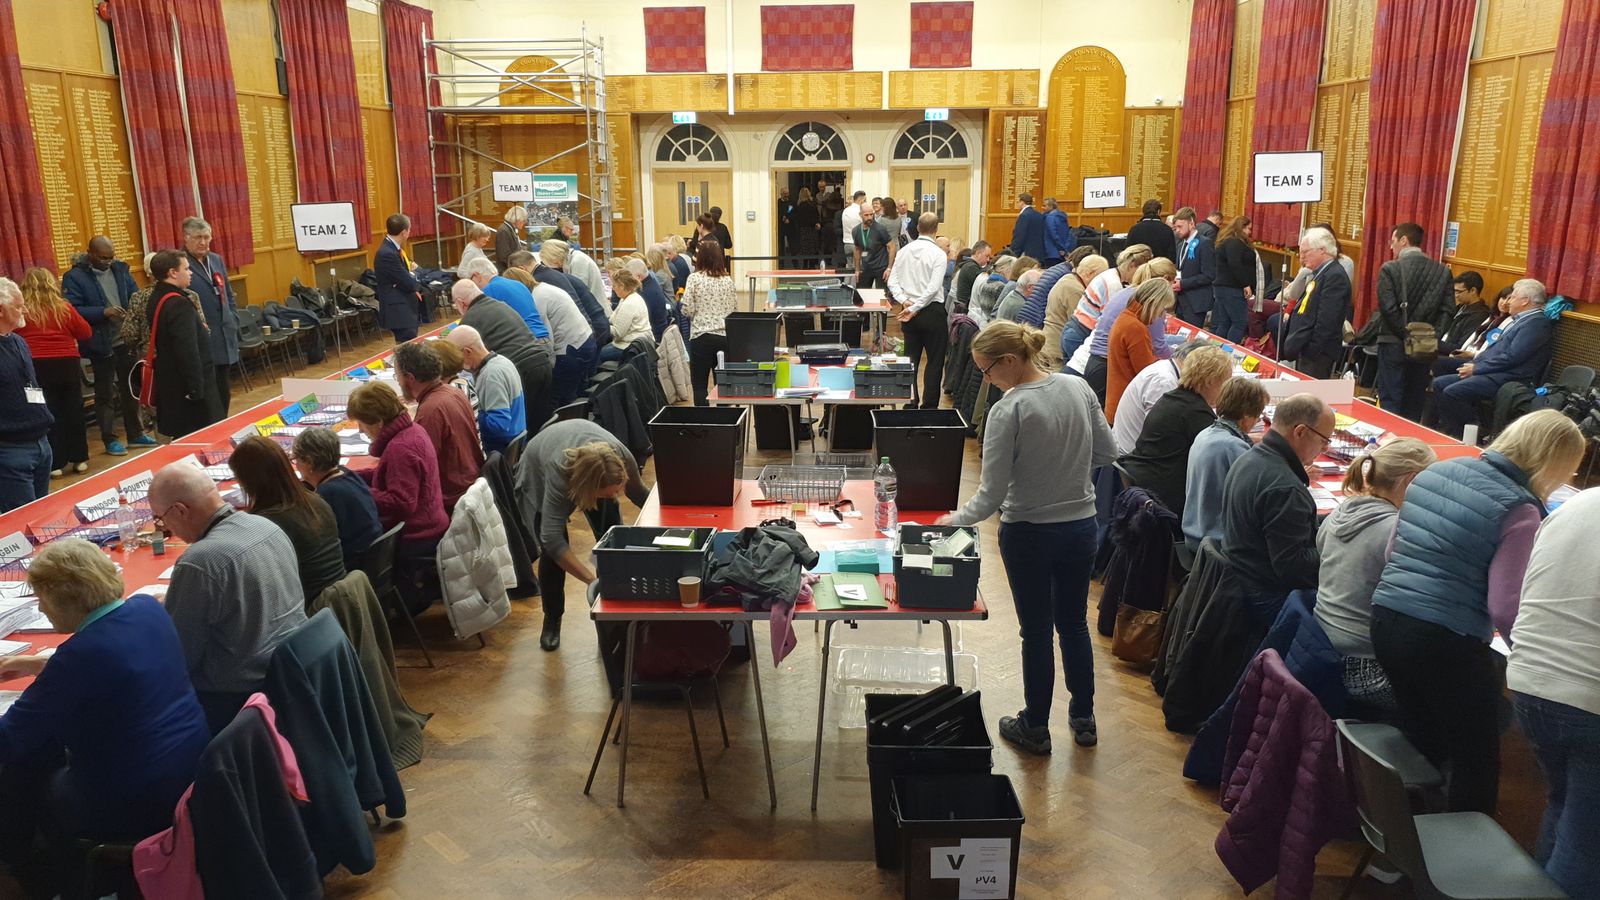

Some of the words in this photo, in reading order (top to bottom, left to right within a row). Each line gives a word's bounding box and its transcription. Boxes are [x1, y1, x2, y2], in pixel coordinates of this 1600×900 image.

[1263, 175, 1302, 187] TEAM
[1306, 174, 1314, 186] 5
[499, 184, 522, 192] TEAM
[524, 184, 529, 192] 3
[1090, 190, 1114, 199] TEAM
[1116, 189, 1122, 197] 6
[301, 224, 337, 236] TEAM
[340, 224, 348, 235] 2
[123, 477, 153, 493] DOUBTFU
[86, 496, 118, 514] WINDSOR
[946, 854, 966, 871] V
[975, 875, 997, 885] PV4
